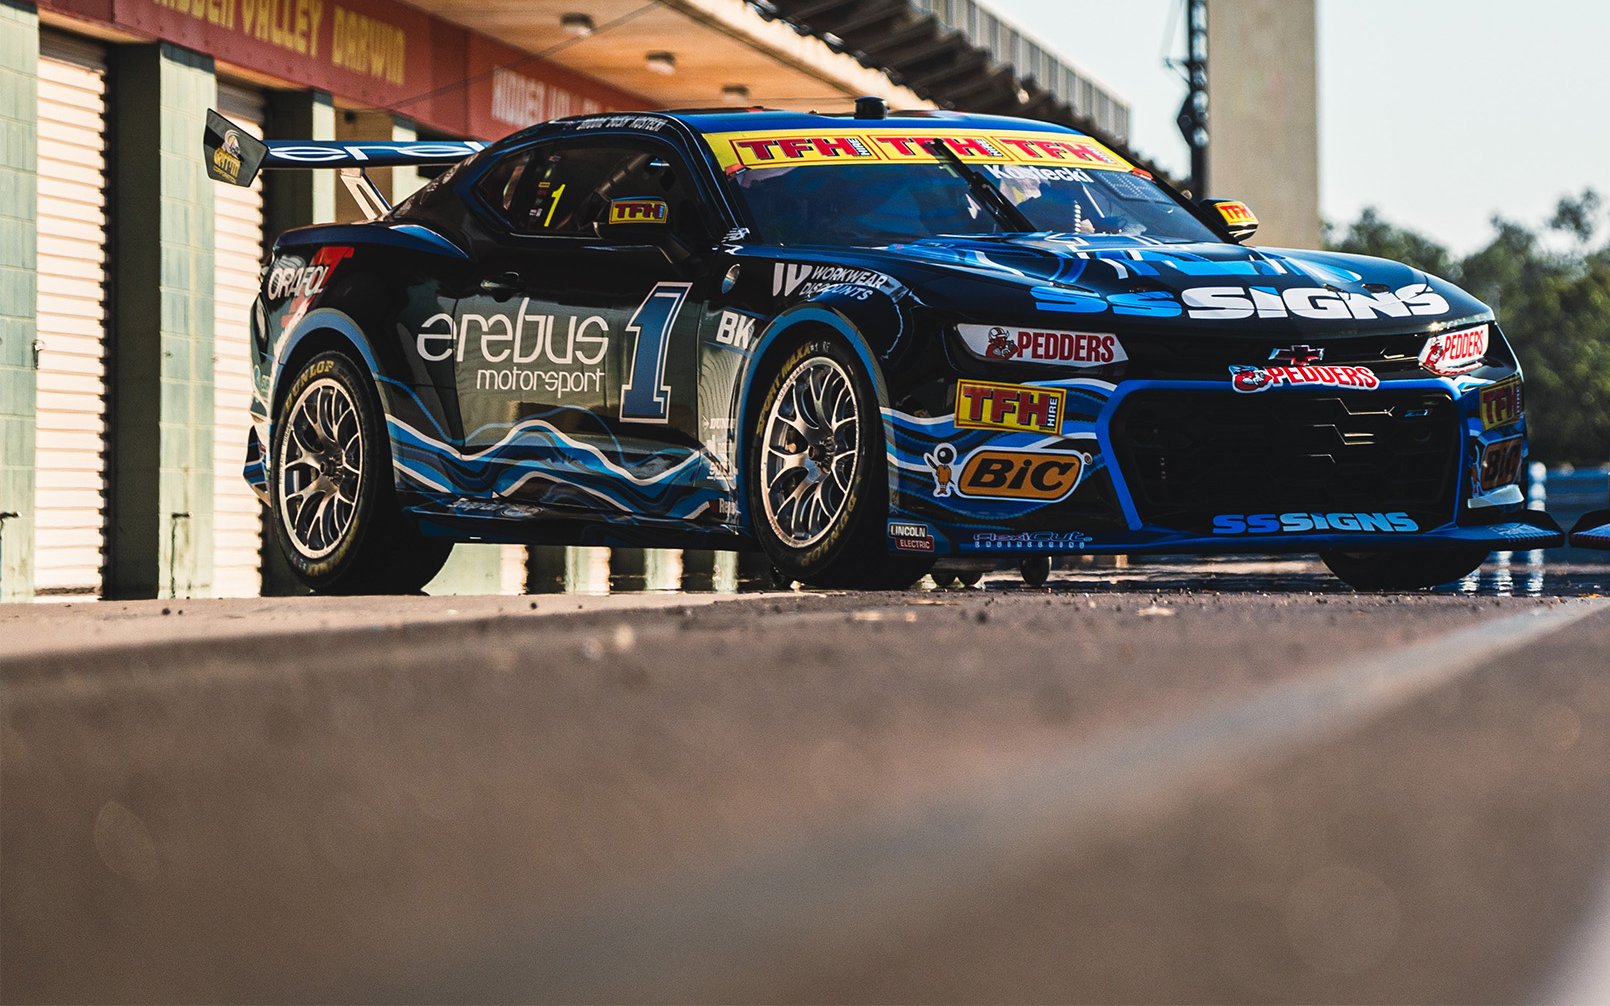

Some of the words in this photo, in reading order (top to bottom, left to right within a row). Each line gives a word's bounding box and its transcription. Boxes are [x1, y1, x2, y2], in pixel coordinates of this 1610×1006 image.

[332, 5, 405, 86] DARWIN
[738, 137, 860, 160] TFH
[1000, 138, 1107, 163] TFH
[983, 164, 1095, 183] Kostecki
[543, 184, 566, 227] 1
[614, 203, 660, 219] TFH
[268, 265, 330, 301] ORAFOL
[799, 282, 874, 301] DISCOUNTS
[811, 265, 888, 289] WORKWEAR
[416, 296, 610, 365] erebus
[1442, 329, 1484, 361] PEDDERS
[619, 281, 694, 424] 1
[1015, 331, 1115, 363] PEDDERS
[285, 359, 334, 412] DUNLOP
[476, 368, 605, 399] motorsport
[1267, 365, 1378, 388] PEDDERS
[962, 385, 1050, 426] TFH
[1046, 396, 1059, 428] HIRE
[1483, 385, 1518, 425] TFH
[889, 525, 928, 538] LINCOLN
[899, 539, 931, 550] ELECTRIC
